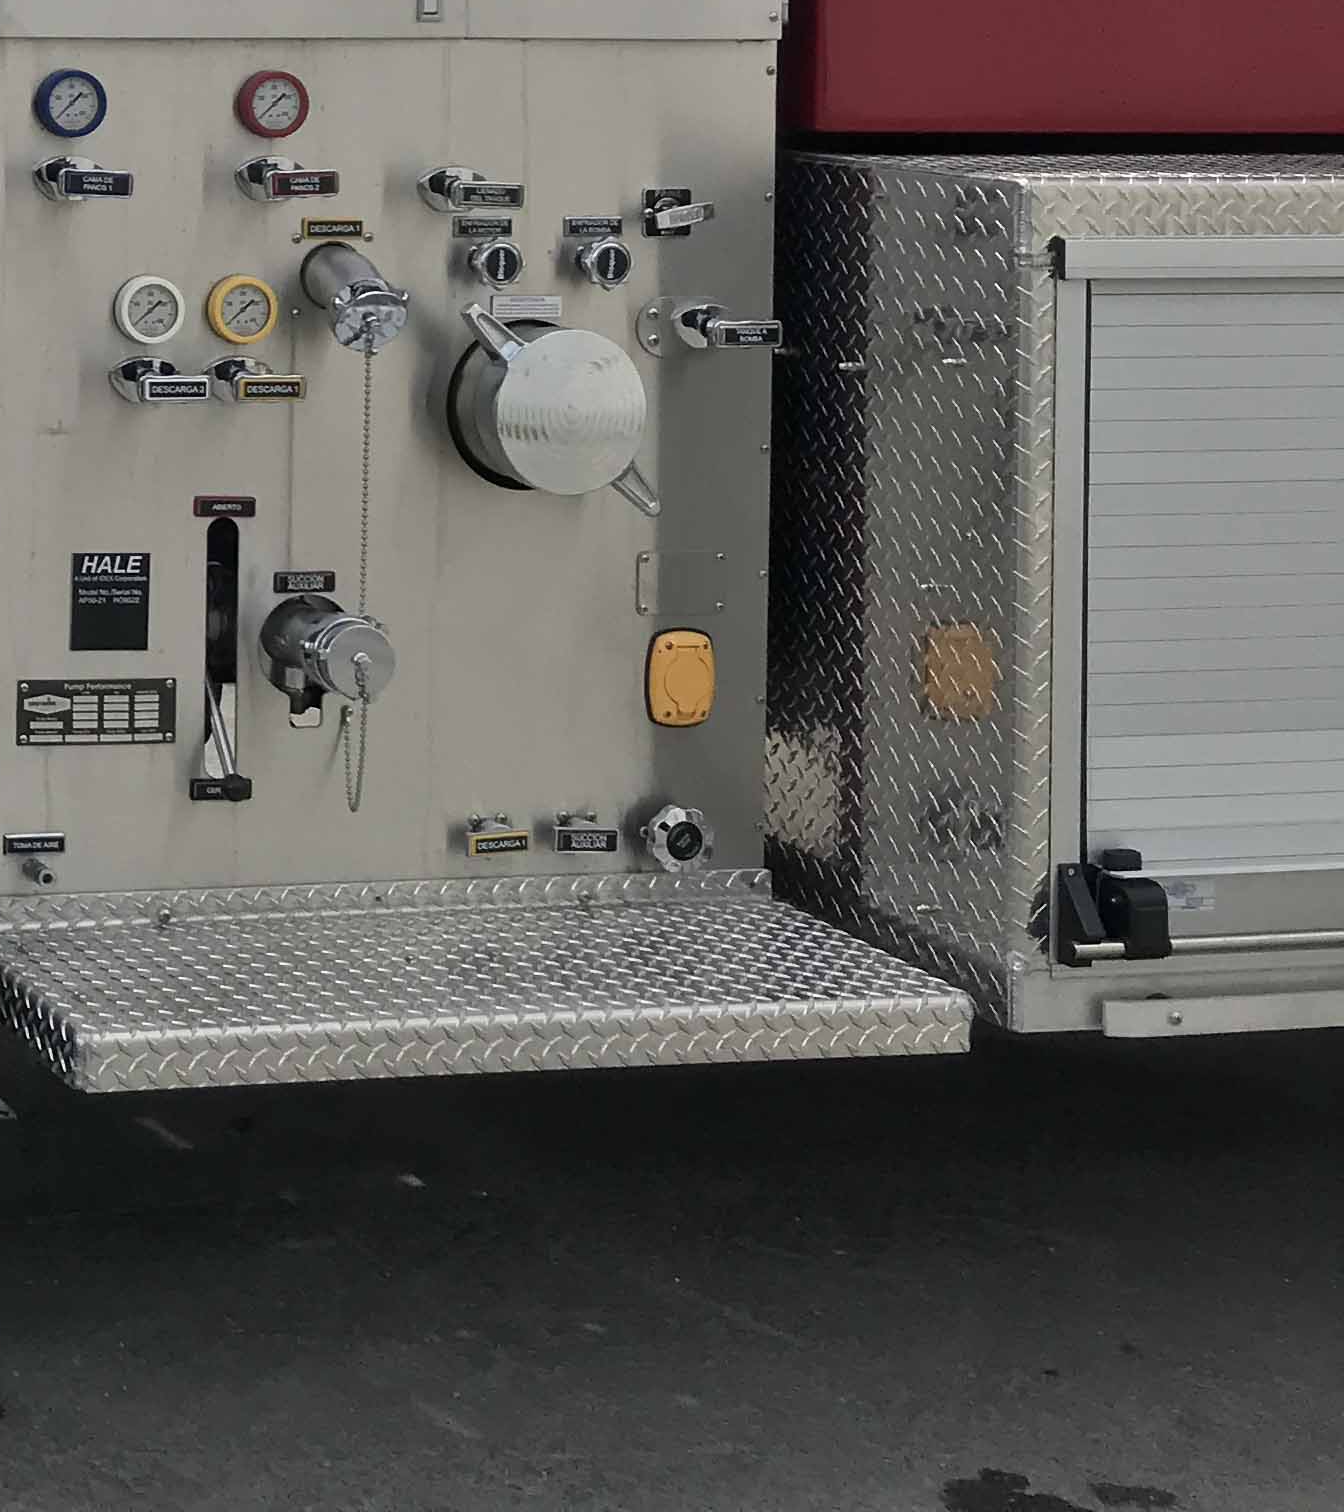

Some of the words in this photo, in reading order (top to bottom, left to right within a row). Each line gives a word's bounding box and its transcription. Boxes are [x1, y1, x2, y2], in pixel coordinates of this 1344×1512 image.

[310, 224, 355, 233] DESCARGA
[151, 384, 198, 394] DESCARGA
[247, 384, 293, 394] DESCARGA
[81, 555, 143, 574] HALE
[477, 839, 521, 851] DESCARGA
